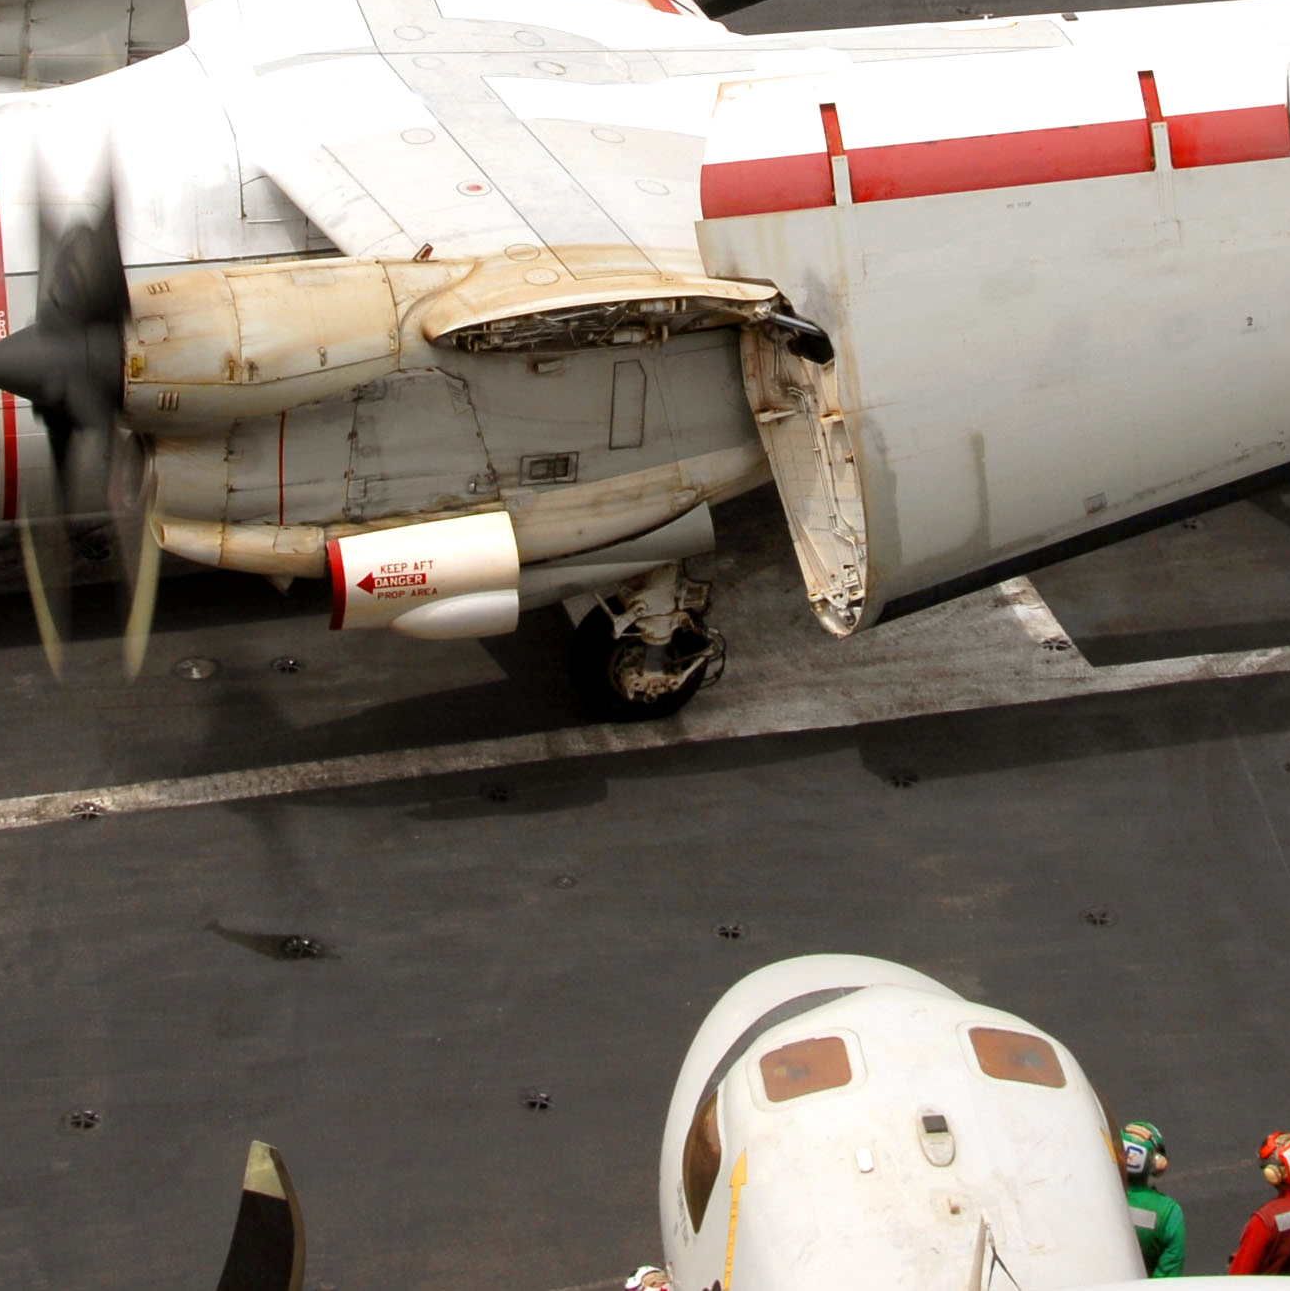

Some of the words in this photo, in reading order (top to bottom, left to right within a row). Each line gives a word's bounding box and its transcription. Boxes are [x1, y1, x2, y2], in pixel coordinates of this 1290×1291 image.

[380, 562, 408, 575] KEEP
[413, 560, 433, 571] AFT
[374, 574, 423, 588] DANGER
[377, 590, 406, 600] PROP
[410, 588, 438, 598] AREA
